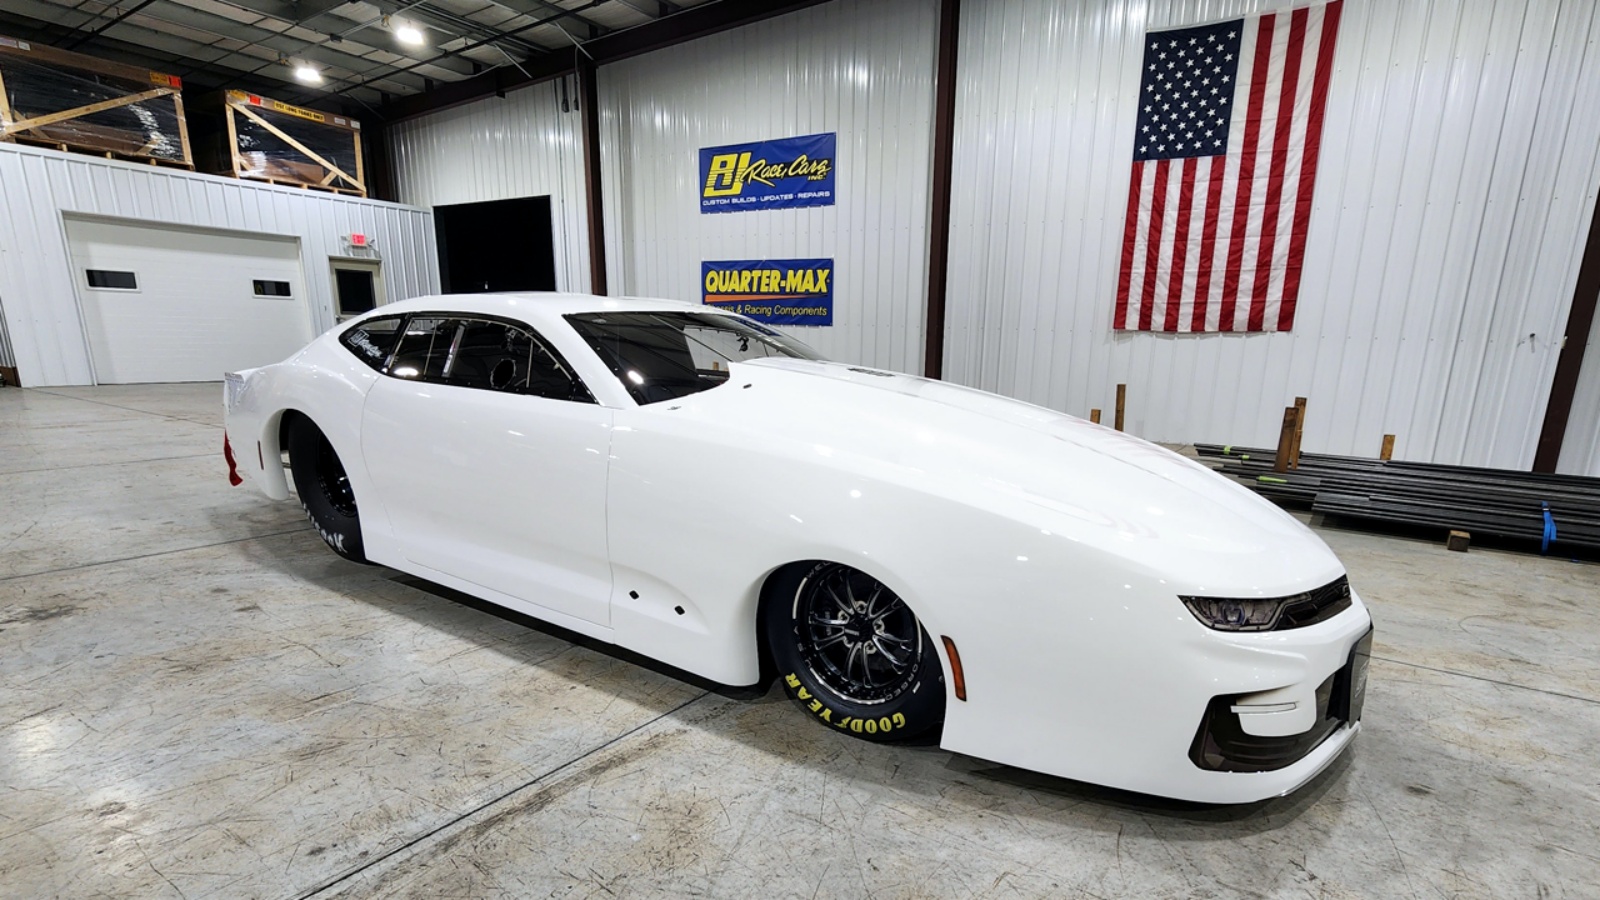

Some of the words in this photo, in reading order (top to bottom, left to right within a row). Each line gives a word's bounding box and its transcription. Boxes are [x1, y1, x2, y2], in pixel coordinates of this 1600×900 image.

[788, 154, 831, 176] Cars
[731, 196, 757, 204] BUILDS
[760, 193, 794, 202] UPDATES
[797, 191, 830, 199] REPAIRS
[705, 269, 829, 293] QUARTER-MAX
[736, 304, 742, 314] &
[744, 304, 772, 317] Racing
[774, 304, 827, 317] Components
